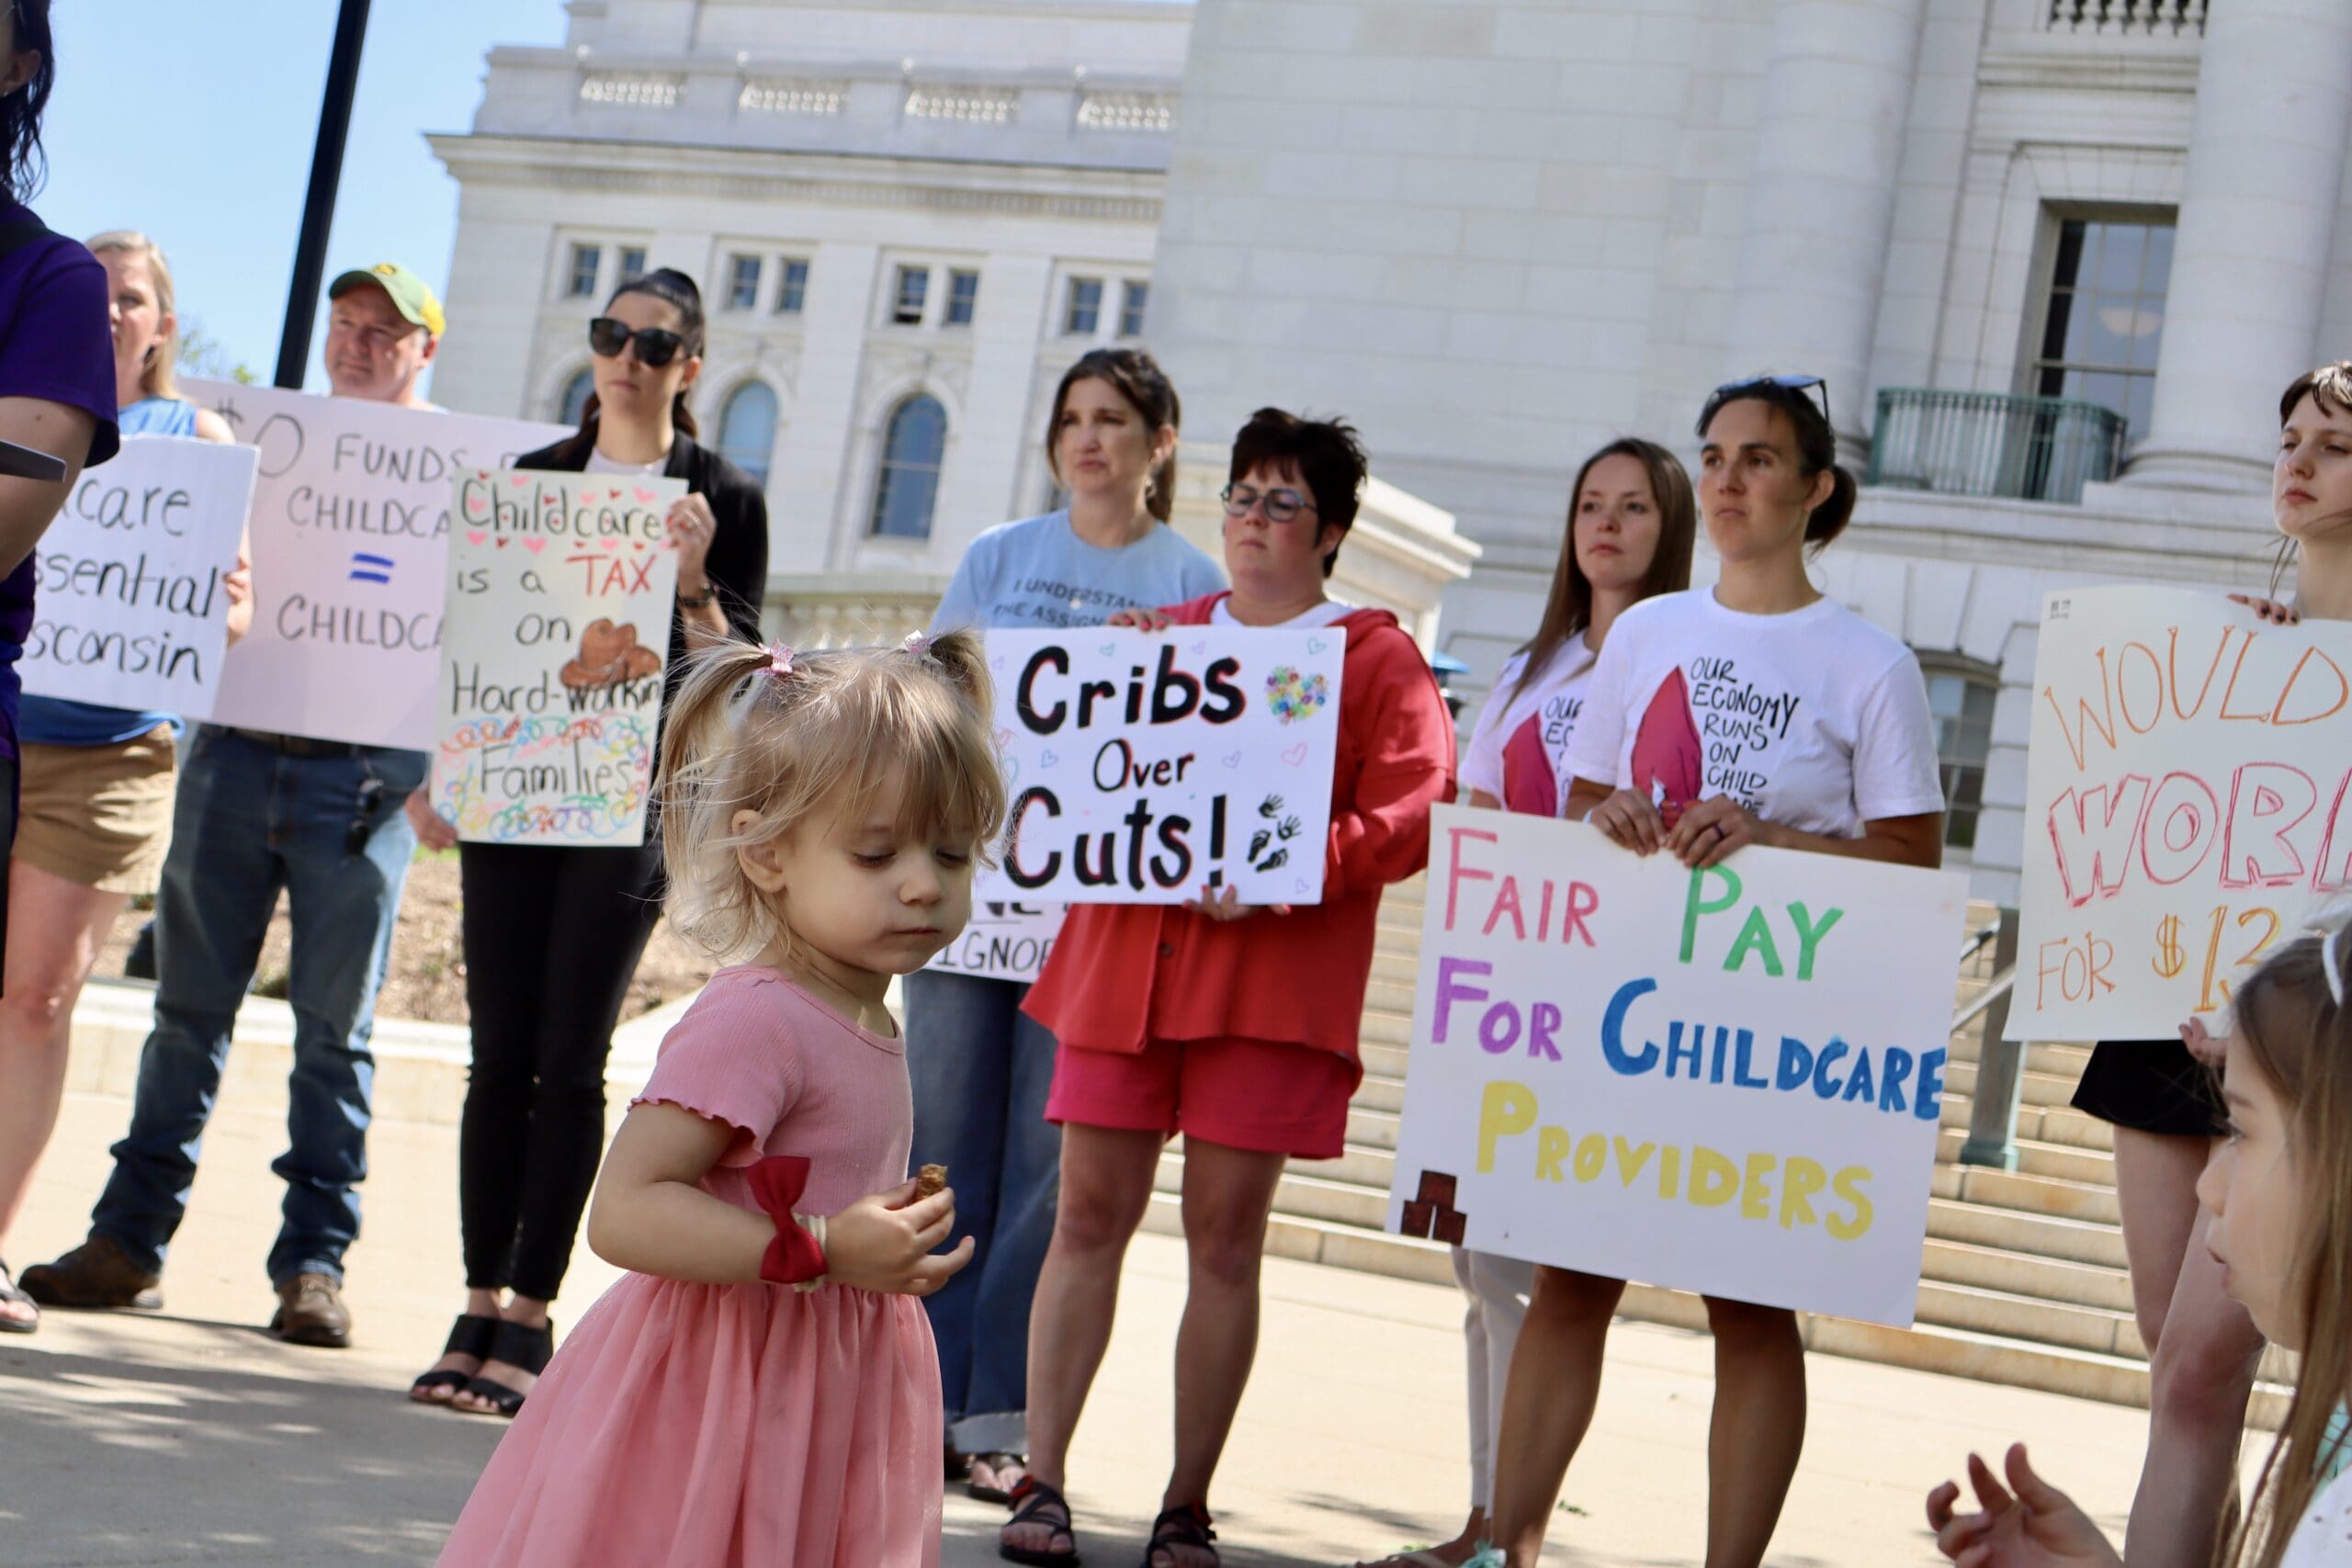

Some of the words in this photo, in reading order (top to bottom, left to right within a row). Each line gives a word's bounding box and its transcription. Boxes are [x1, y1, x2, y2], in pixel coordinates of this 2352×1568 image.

[62, 478, 191, 537] care
[461, 477, 664, 542] Childcare
[457, 555, 491, 595] is
[519, 570, 547, 594] a
[565, 553, 659, 598] TAX
[515, 612, 571, 647] on
[1016, 644, 1248, 736] Cribs
[1690, 657, 1738, 684] OUR
[2043, 625, 2349, 773] WOULD
[1691, 682, 1801, 740] ECONOMY
[1703, 713, 1769, 752] RUNS
[479, 738, 634, 801] Families
[1092, 737, 1195, 793] Over
[1706, 764, 1769, 796] CHILD
[1709, 741, 1743, 765] ON
[1002, 785, 1228, 891] Cuts!
[1443, 826, 1600, 948] FAIR
[1678, 863, 1845, 982] PAY
[2036, 931, 2117, 1012] FOR
[1430, 955, 1563, 1063] FOR
[1600, 976, 1948, 1121] CHILDCARE
[1475, 1079, 1874, 1241] PROVIDERS
